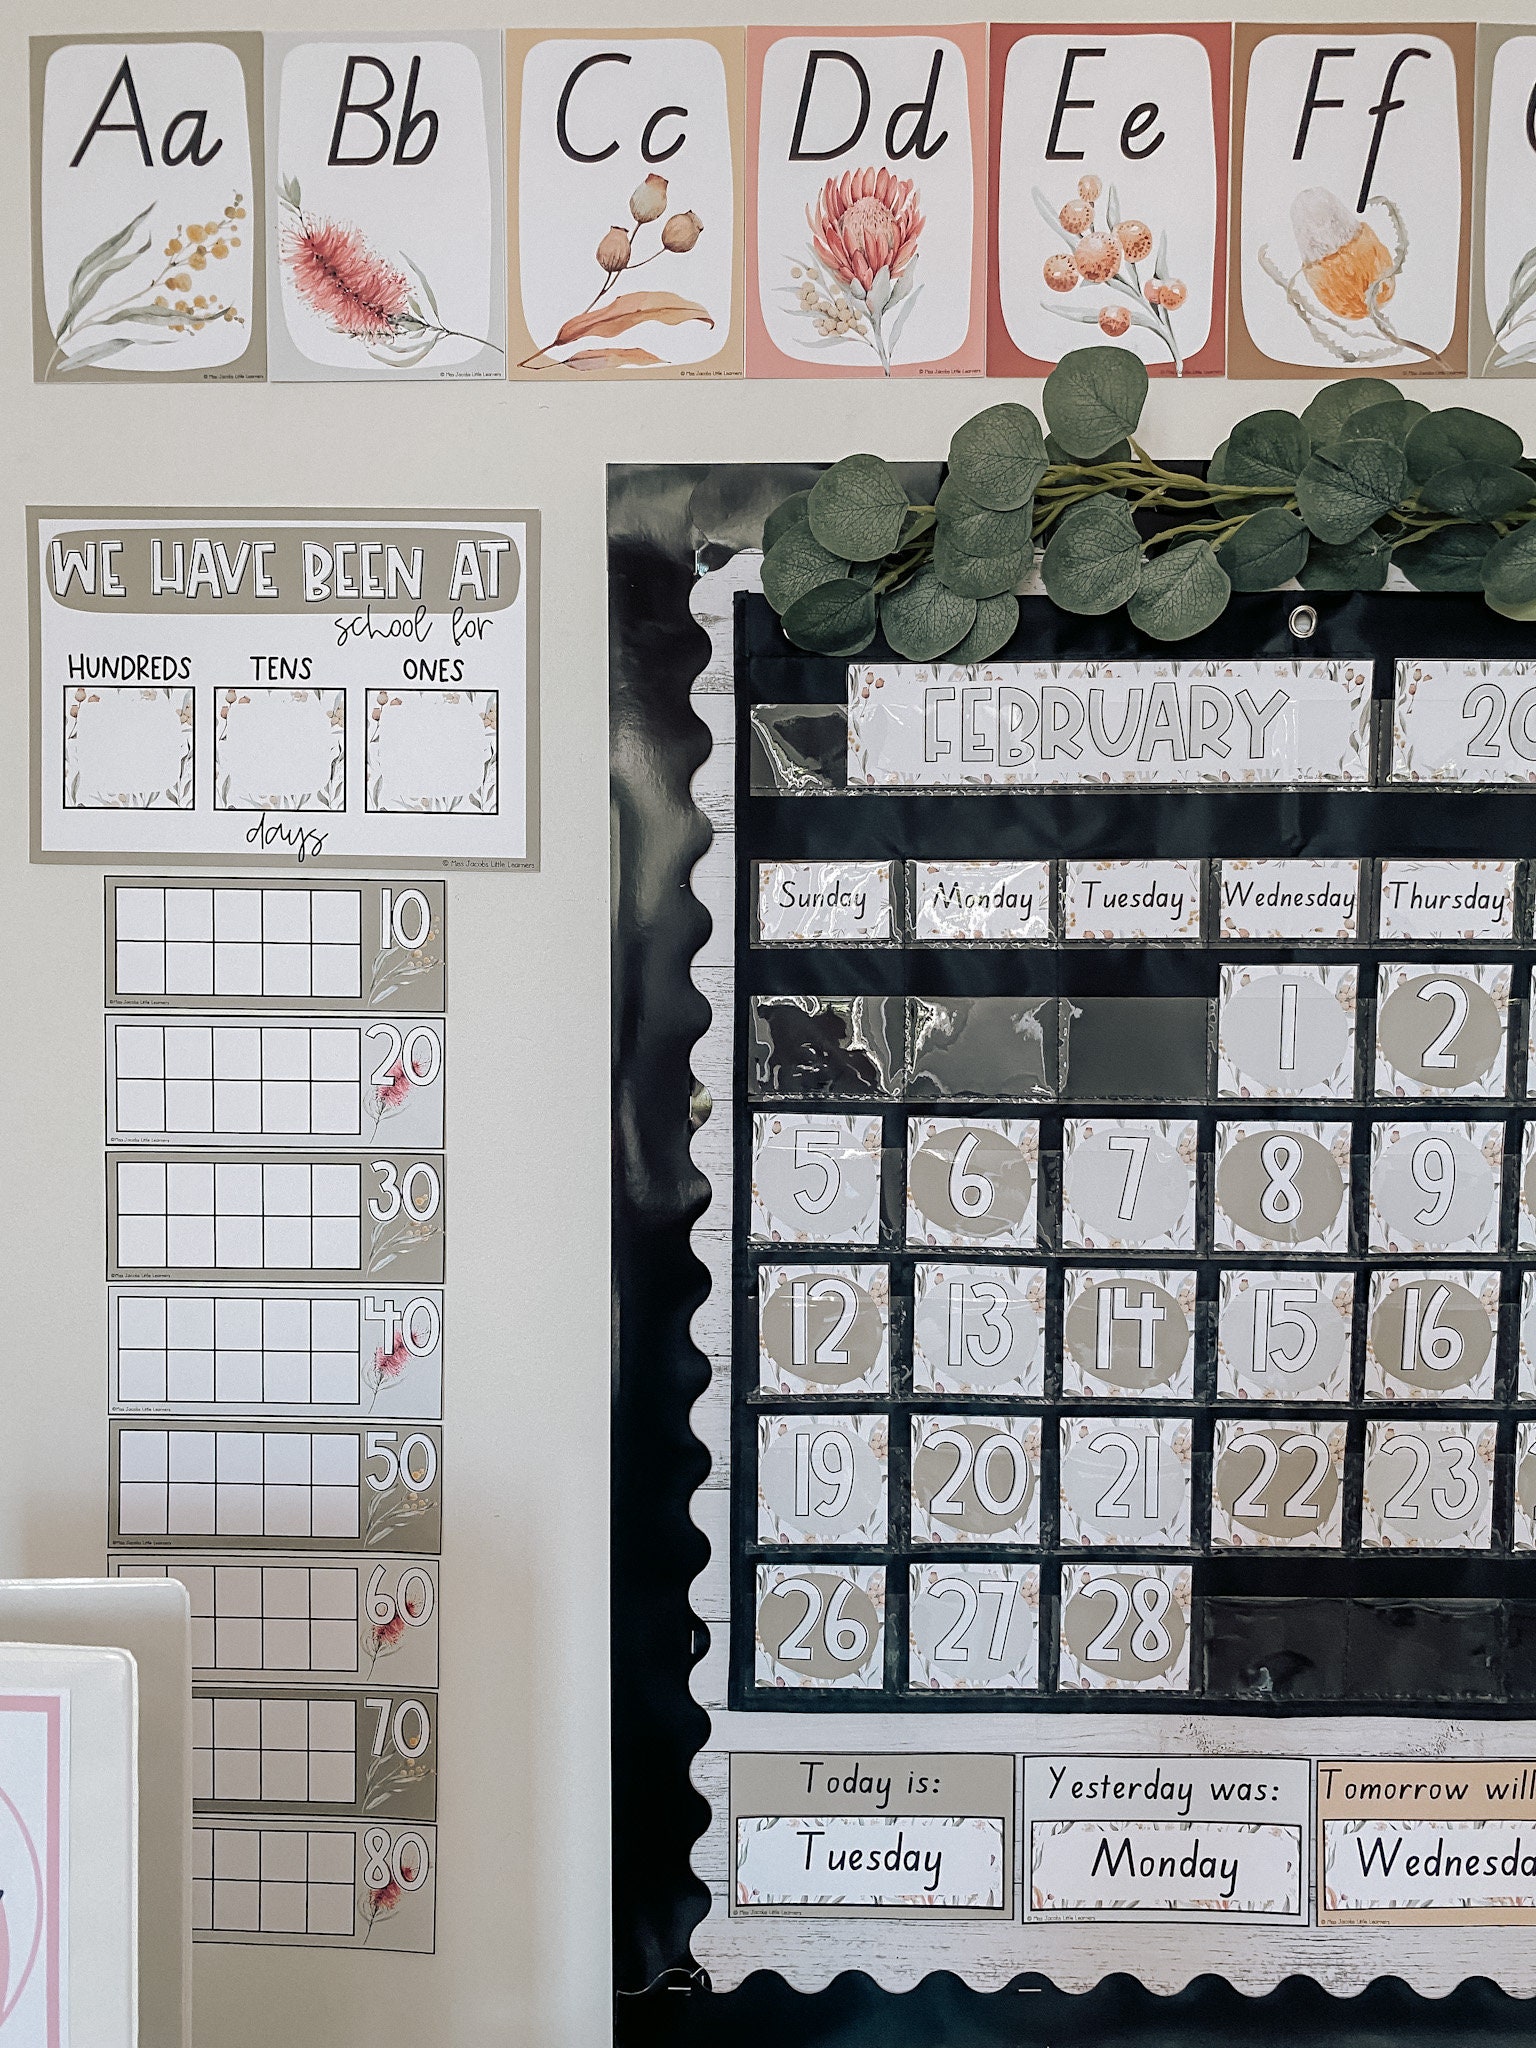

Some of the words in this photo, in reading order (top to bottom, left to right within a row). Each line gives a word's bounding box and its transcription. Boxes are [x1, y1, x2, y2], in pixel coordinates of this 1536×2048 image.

[69, 54, 222, 168] Aa
[327, 55, 439, 166] Bb
[556, 52, 688, 163] Cc
[788, 49, 949, 161] Dd
[1045, 48, 1165, 160] Ee
[1292, 48, 1431, 213] Ff
[51, 540, 127, 598] WE
[152, 539, 280, 599] HAVE
[303, 541, 425, 603] BEEN
[449, 541, 511, 601] AT
[68, 653, 192, 681] HUNDREDS
[334, 605, 433, 647] school
[452, 607, 494, 646] for
[250, 656, 313, 681] TENS
[402, 658, 465, 683] ONES
[924, 682, 1291, 767] FEBRUARY
[246, 813, 328, 863] days
[465, 860, 489, 868] Jacobs
[507, 861, 535, 869] Learners
[379, 888, 431, 950] 10
[779, 880, 867, 920] Sunday
[932, 881, 1033, 921] Monday
[1082, 880, 1184, 921] Tuesday
[1223, 880, 1356, 919] Wednesday
[1388, 881, 1507, 922] Thursday
[364, 1023, 441, 1087] 20
[1279, 983, 1298, 1071] 1
[1416, 979, 1469, 1069] 2
[367, 1160, 440, 1222] 30
[793, 1131, 841, 1215] 5
[948, 1133, 994, 1218] 6
[1107, 1136, 1150, 1221] 7
[1260, 1136, 1304, 1225] 8
[1411, 1137, 1456, 1226] 9
[364, 1295, 441, 1358] 40
[791, 1277, 859, 1367] 12
[947, 1281, 1014, 1367] 13
[1095, 1286, 1167, 1370] 14
[1252, 1288, 1319, 1373] 15
[1399, 1283, 1464, 1371] 16
[363, 1431, 438, 1493] 50
[794, 1429, 856, 1518] 19
[922, 1430, 1030, 1516] 20
[1089, 1431, 1161, 1519] 21
[1227, 1432, 1331, 1519] 22
[1383, 1433, 1481, 1520] 23
[365, 1563, 435, 1628] 60
[777, 1577, 869, 1662] 26
[928, 1576, 1019, 1662] 27
[1085, 1576, 1173, 1663] 28
[364, 1698, 431, 1759] 70
[799, 1761, 892, 1809] Today
[907, 1771, 941, 1794] is:
[1048, 1765, 1193, 1817] Yesterday
[1210, 1782, 1280, 1802] was:
[1319, 1768, 1469, 1800] Tomorrow
[1486, 1769, 1536, 1800] will
[363, 1827, 430, 1892] 80
[796, 1831, 942, 1891] Tuesday
[1091, 1838, 1239, 1898] Monday
